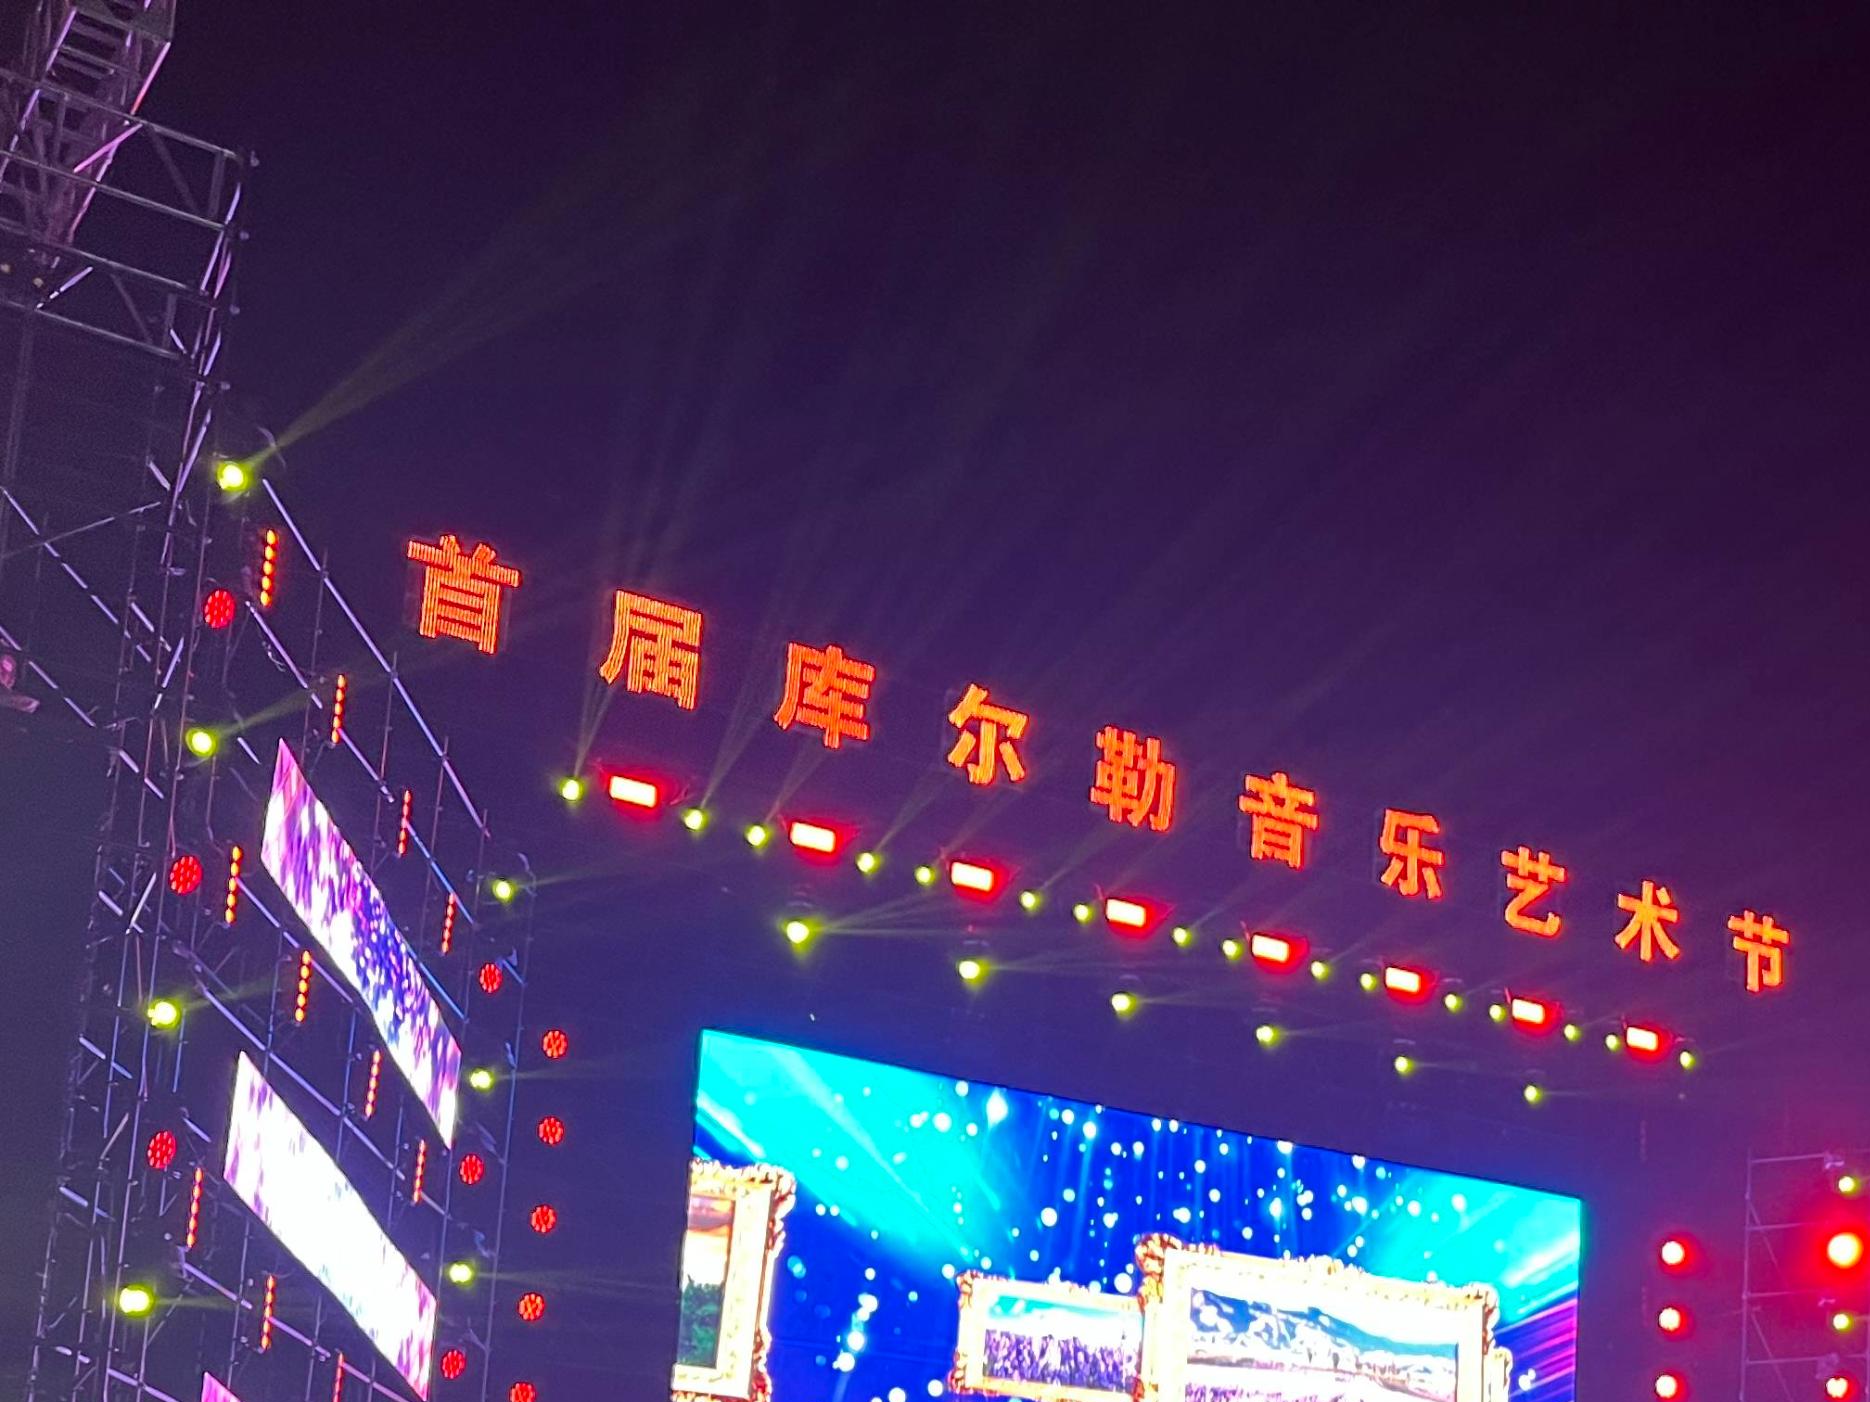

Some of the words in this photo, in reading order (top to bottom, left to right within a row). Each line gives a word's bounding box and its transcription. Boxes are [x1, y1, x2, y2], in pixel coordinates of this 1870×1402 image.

[406, 532, 1791, 994] 首届库尔勒音乐艺术节
